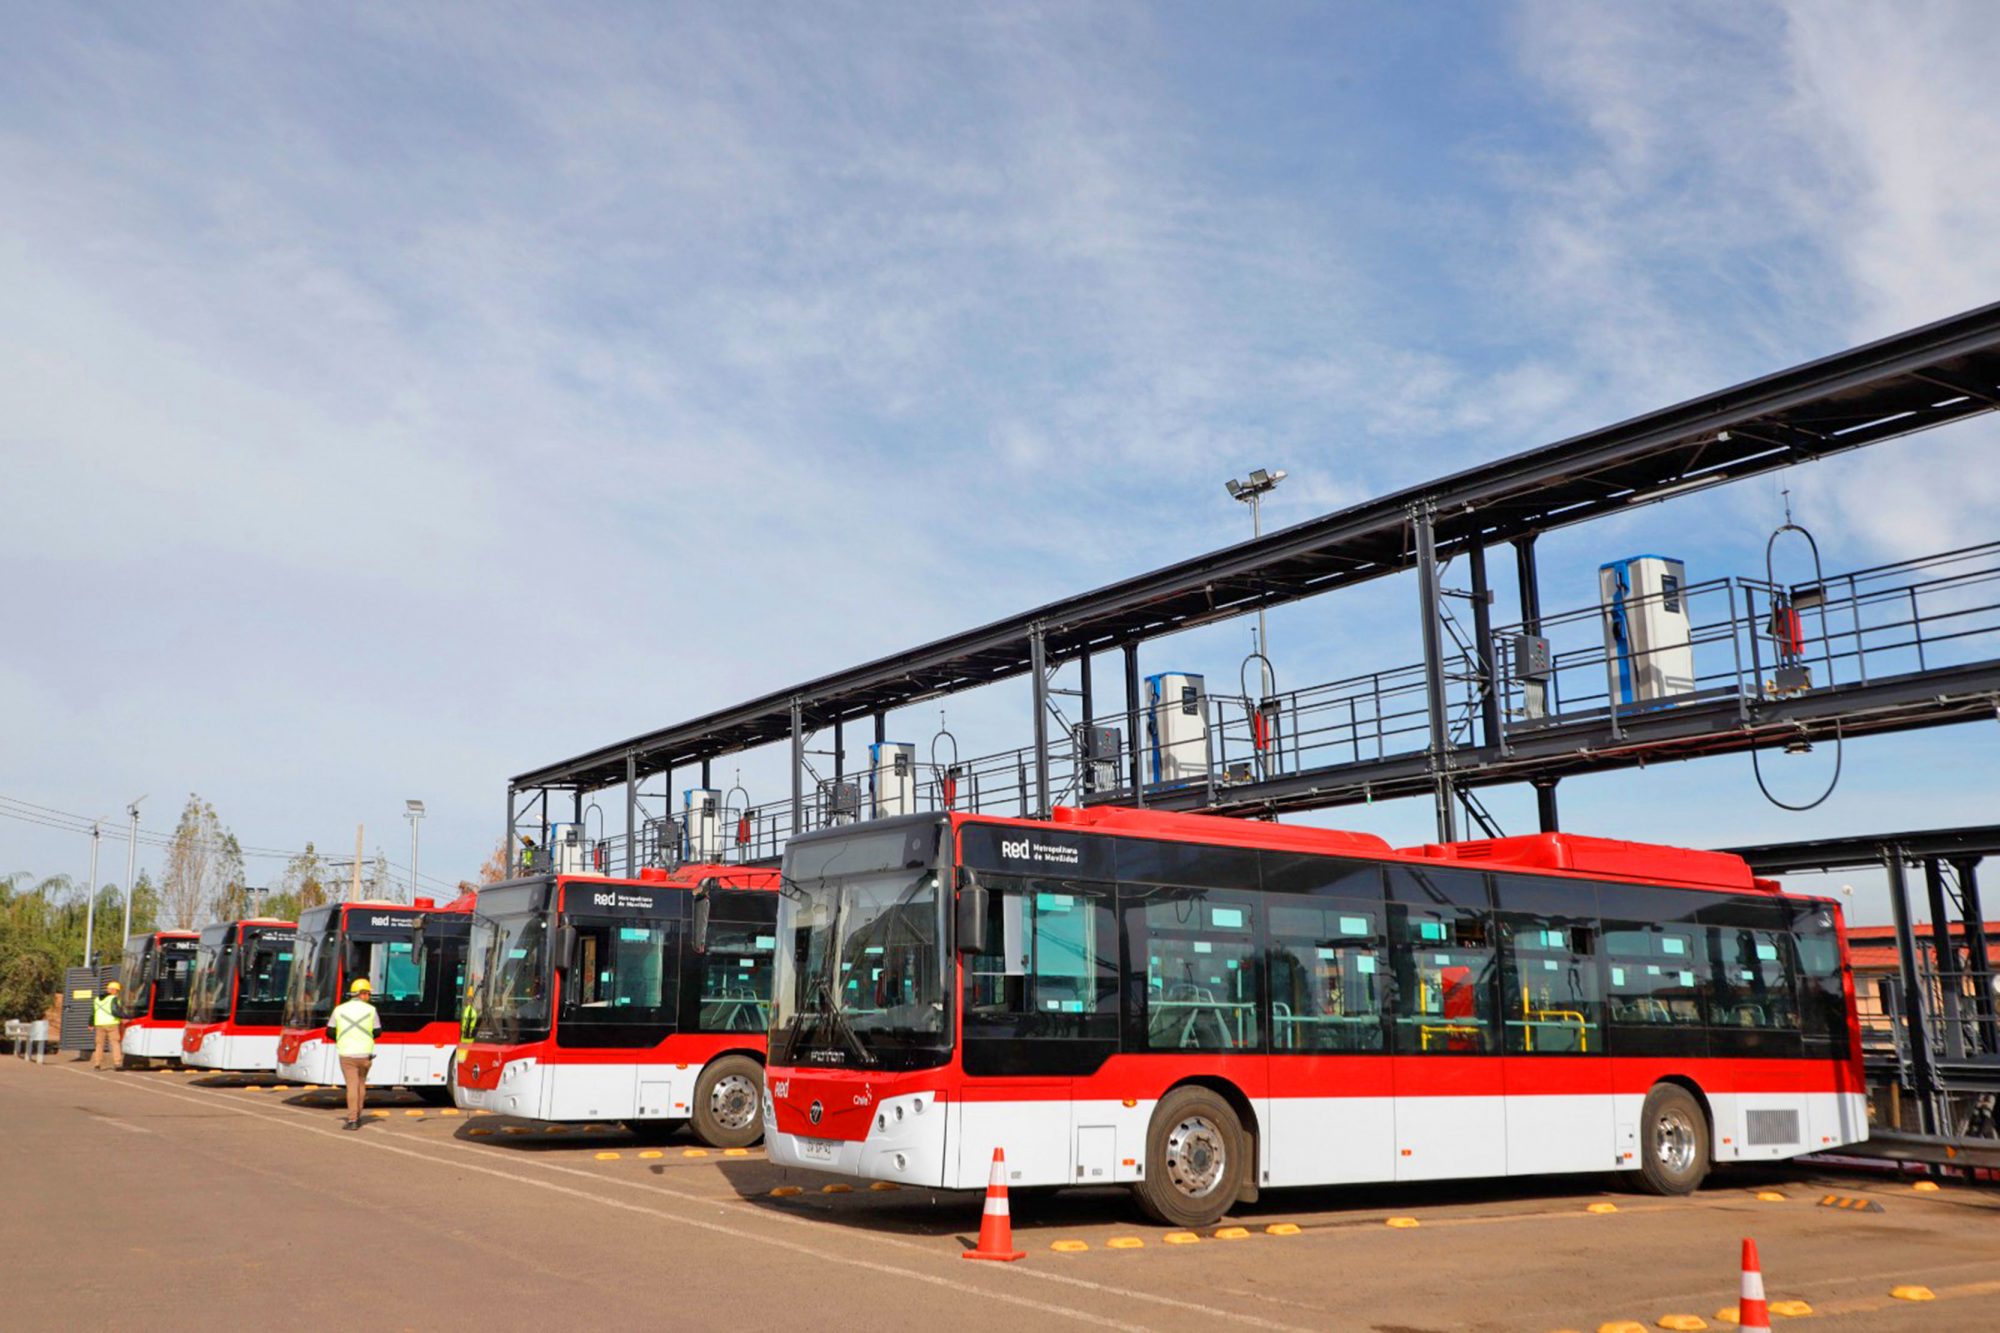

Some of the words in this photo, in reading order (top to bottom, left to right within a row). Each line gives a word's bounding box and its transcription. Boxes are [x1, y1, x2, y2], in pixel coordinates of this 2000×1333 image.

[1002, 839, 1030, 859] Red
[1033, 843, 1078, 855] Metropolitana
[1033, 852, 1042, 861] de
[1044, 853, 1078, 863] Movilidad
[594, 892, 616, 906] Red
[775, 1077, 790, 1098] Red
